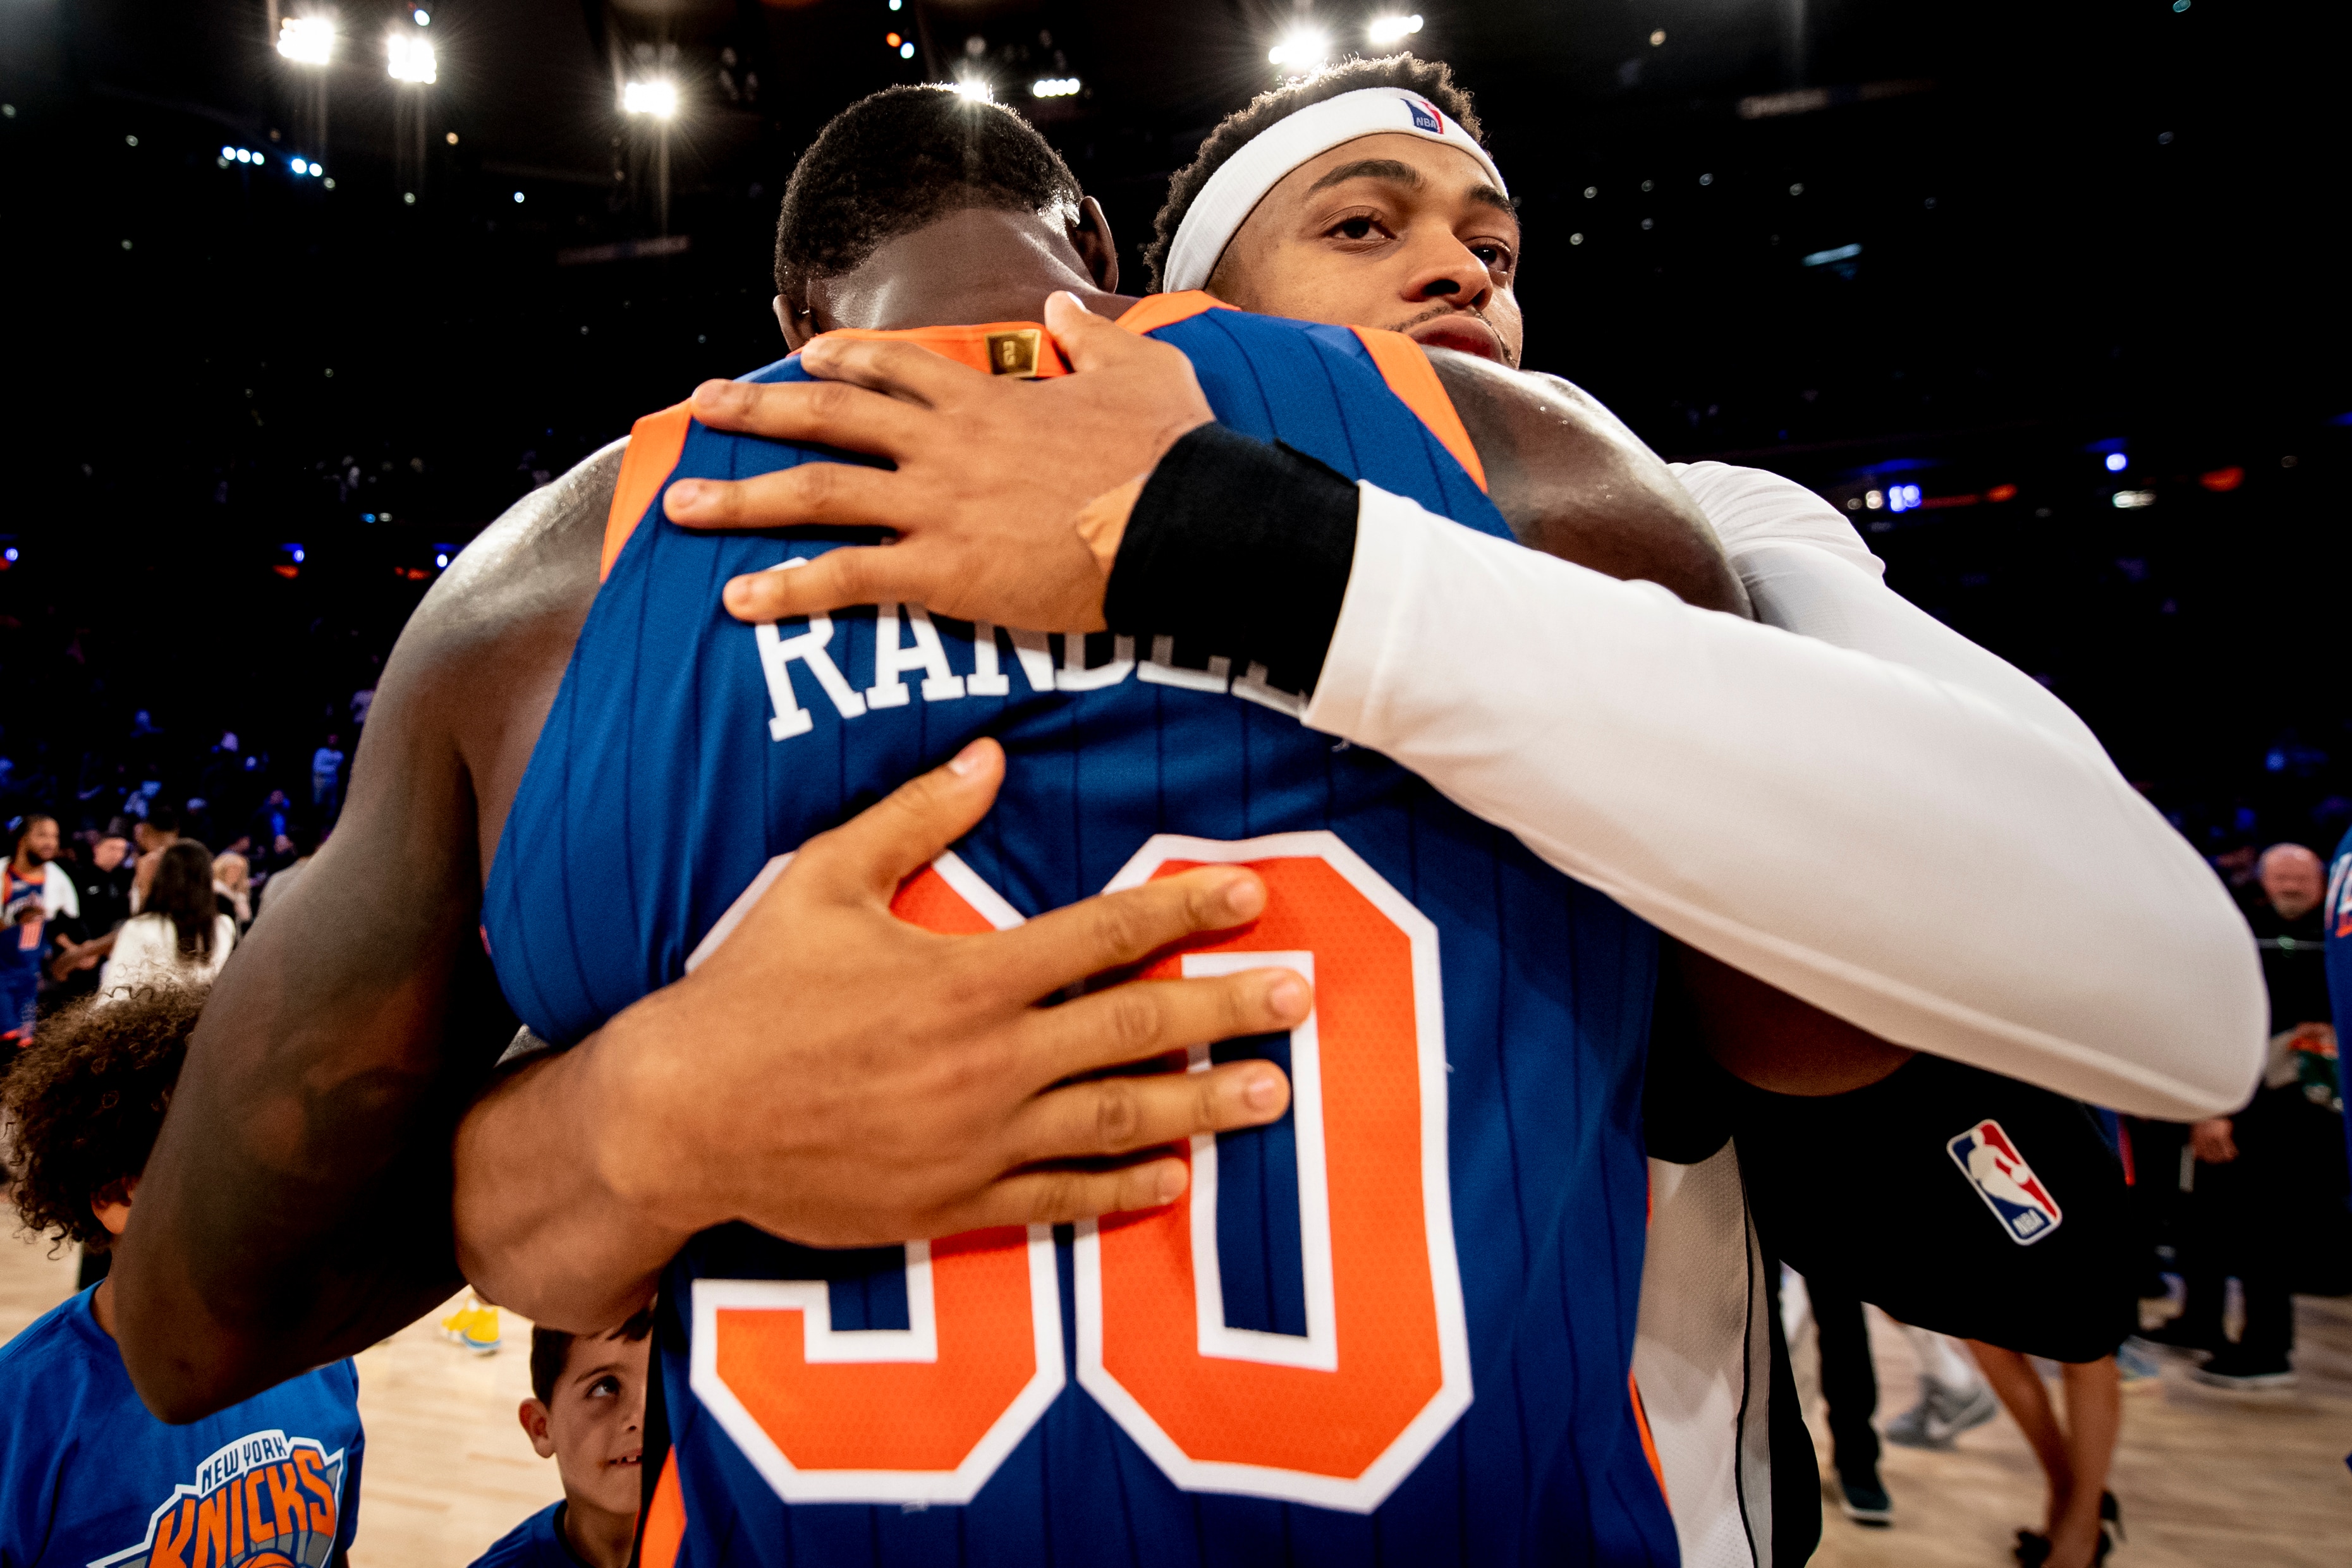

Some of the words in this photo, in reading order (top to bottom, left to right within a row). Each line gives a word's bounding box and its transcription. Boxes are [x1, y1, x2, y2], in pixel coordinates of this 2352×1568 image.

[1416, 117, 1437, 128] NBA
[201, 1452, 239, 1495] NEW
[243, 1436, 288, 1467] YORK
[148, 1449, 337, 1568] KNICKS
